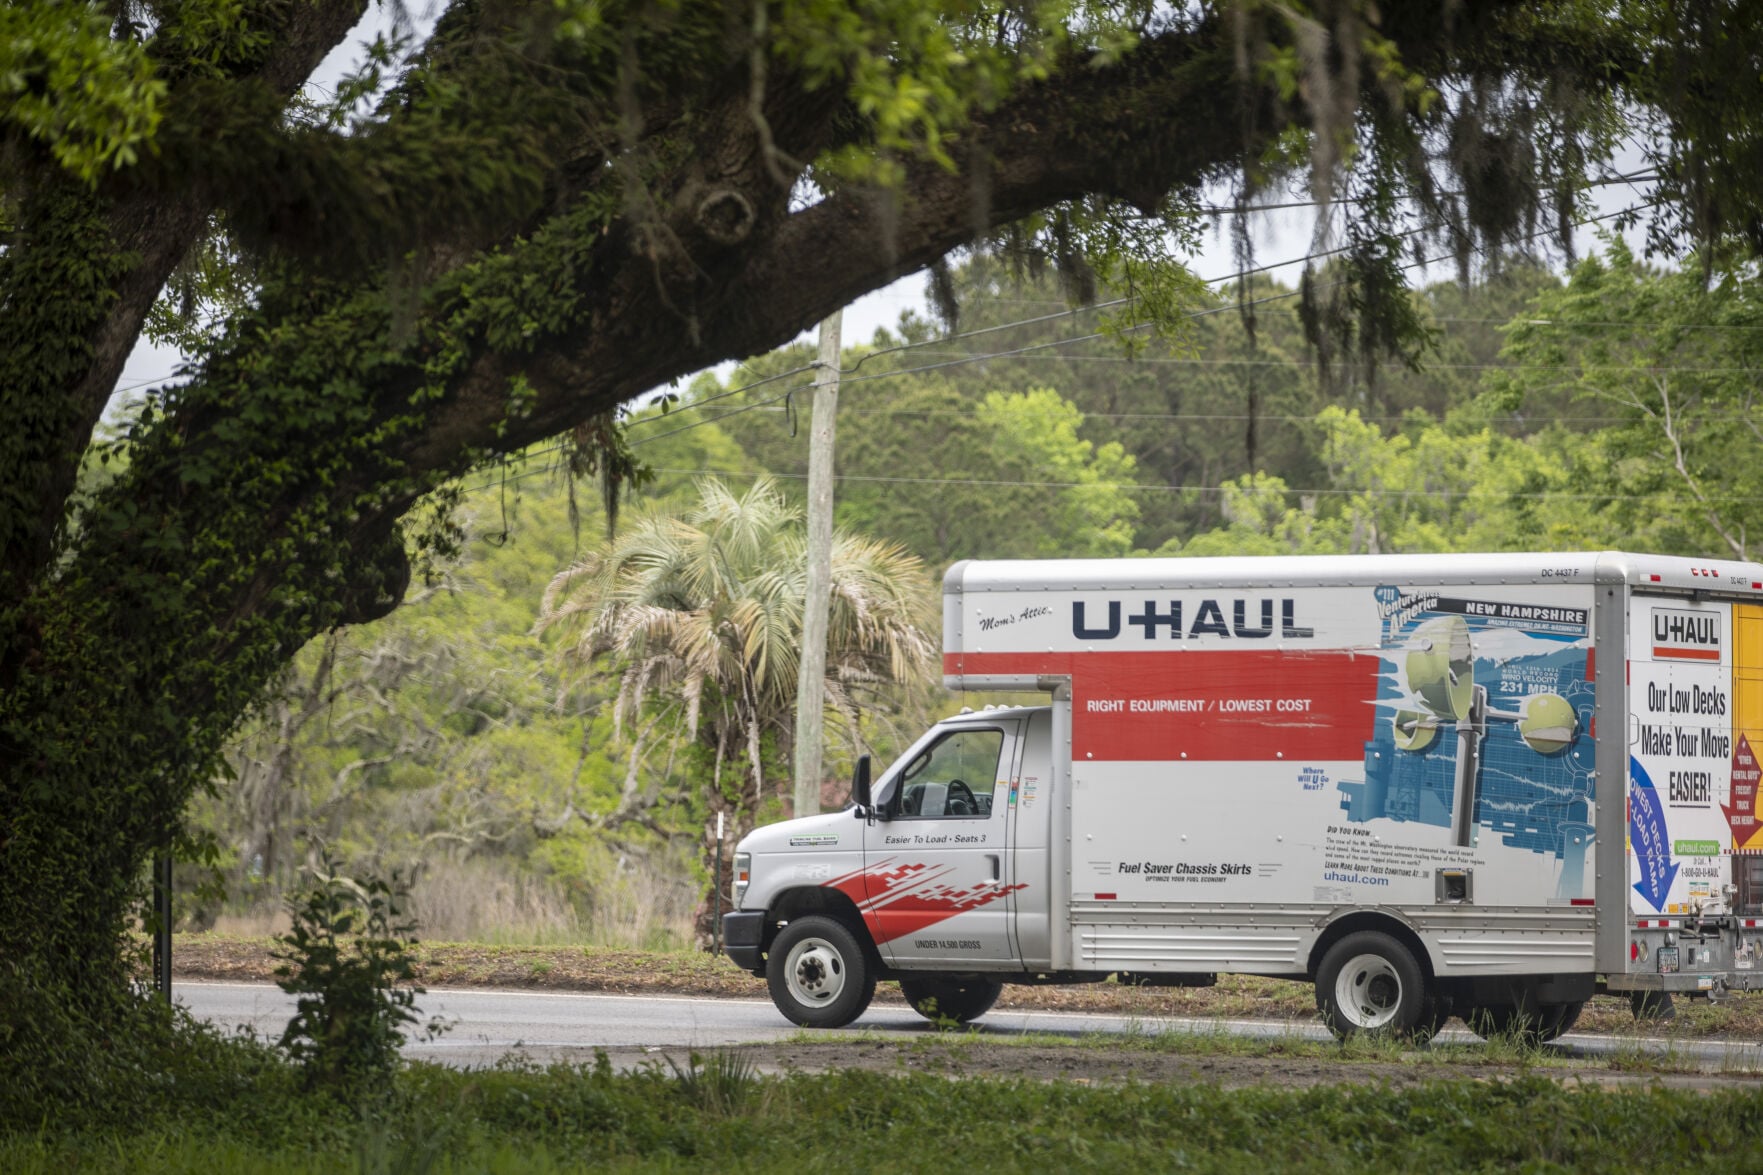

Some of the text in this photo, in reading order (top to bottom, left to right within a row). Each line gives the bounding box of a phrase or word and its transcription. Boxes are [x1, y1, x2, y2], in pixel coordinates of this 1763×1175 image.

[1541, 569, 1552, 577] DC
[1072, 599, 1314, 640] U-HAUL
[1466, 602, 1584, 623] NEW HAMPSHIRE
[1654, 614, 1718, 645] U-HAUL
[1523, 675, 1559, 684] VELOCITY
[1500, 681, 1558, 695] 231 MPH
[1087, 699, 1125, 712] RIGHT
[1130, 699, 1205, 712] EQUIPMENT
[1219, 699, 1272, 712] LOWEST
[1276, 699, 1312, 712] COST
[1648, 681, 1726, 716] Our Low Decks
[1642, 725, 1730, 759] Make Your Move
[1302, 766, 1324, 774] Where
[1298, 775, 1310, 783] Will
[1312, 774, 1319, 784] U
[1670, 771, 1711, 802] EASIER!
[1630, 778, 1666, 879] OWEST DECKS
[885, 834, 986, 844] Easier To Load Seats 3
[1678, 842, 1716, 854] uhaul.com
[1118, 862, 1142, 874] Fuel
[1176, 862, 1217, 875] Chassis
[1220, 863, 1252, 876] Skirts
[1324, 861, 1339, 870] LEARN
[1340, 862, 1352, 871] MORE
[1354, 864, 1370, 873] ABOUT
[1370, 864, 1384, 874] THESE
[1647, 847, 1658, 898] RAMP
[1200, 876, 1226, 884] ECONOMY
[1324, 871, 1389, 886] uhaul.com
[915, 940, 938, 949] UNDER
[959, 940, 982, 950] GROSS
